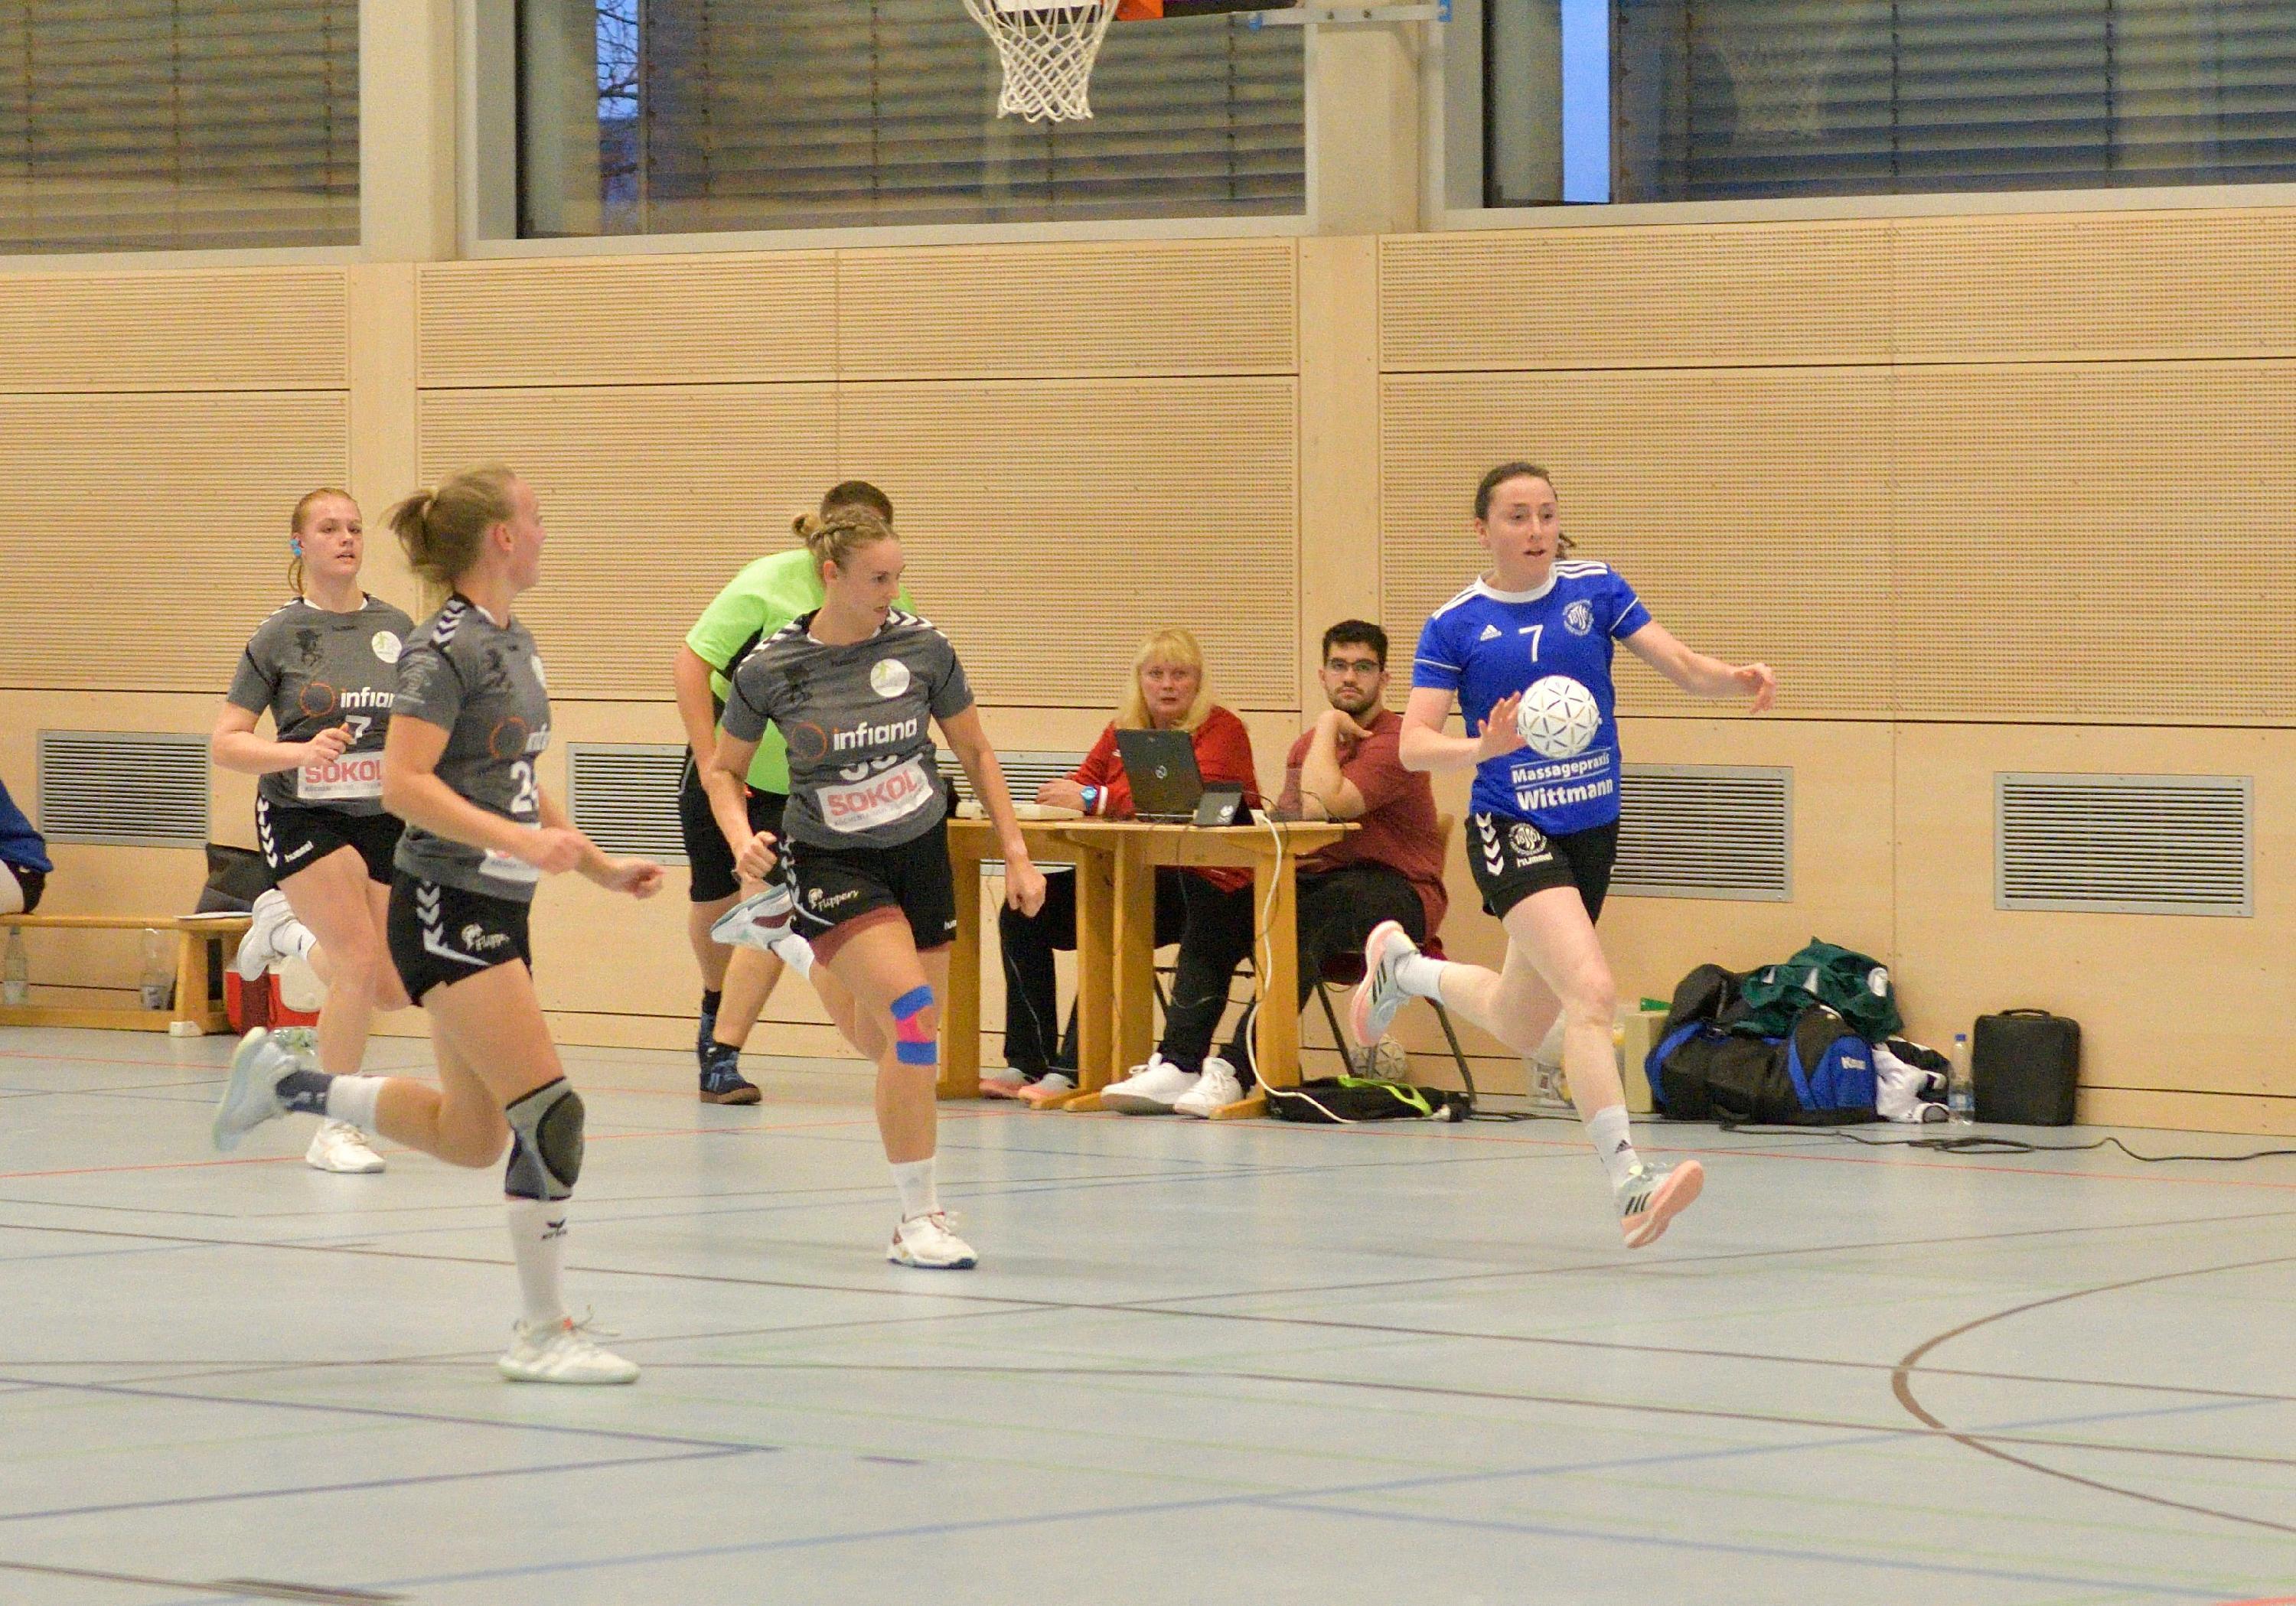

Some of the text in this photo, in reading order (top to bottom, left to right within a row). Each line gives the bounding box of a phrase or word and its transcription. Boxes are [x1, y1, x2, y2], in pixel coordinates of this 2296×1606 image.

[1518, 624, 1544, 663] 7
[345, 715, 372, 745] 7
[832, 718, 918, 751] infiana
[1512, 752, 1610, 784] Massagepraxis
[827, 770, 918, 816] SOKOL
[1516, 777, 1613, 811] Wittmann
